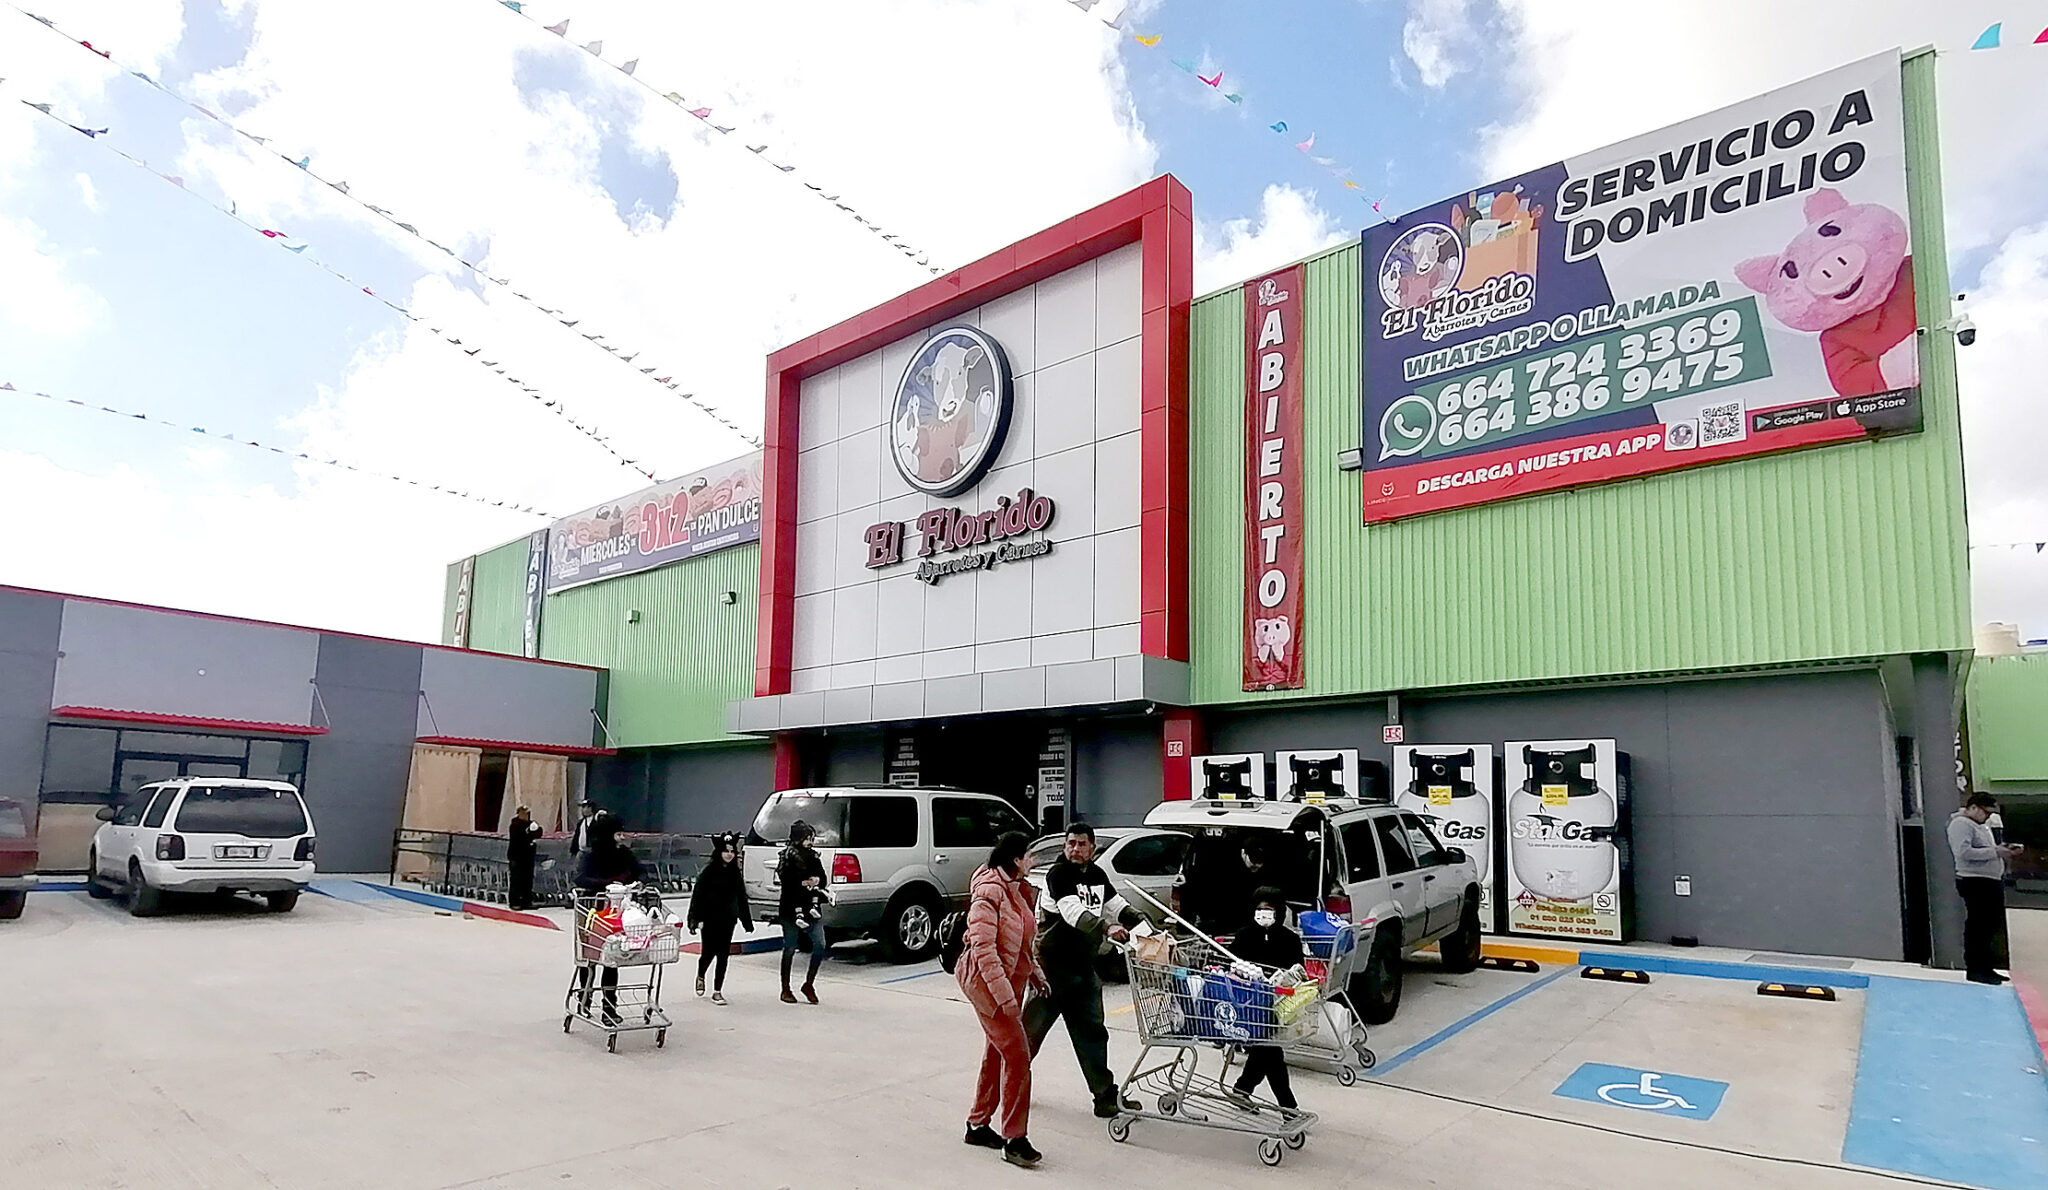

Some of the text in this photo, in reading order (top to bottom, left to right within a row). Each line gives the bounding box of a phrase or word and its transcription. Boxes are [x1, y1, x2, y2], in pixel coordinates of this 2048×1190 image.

[1560, 88, 1874, 216] SERVICIO A
[1570, 141, 1866, 257] DOMICILIO
[1383, 277, 1529, 336] El Florido
[1405, 280, 1721, 378] WHATSAPP O LLAMADA
[1425, 302, 1529, 338] Abarrotes y Carnes
[1437, 308, 1742, 416] 664 724 3369
[1438, 343, 1744, 447] 664 386 9475
[1773, 411, 1805, 427] Google
[1806, 409, 1824, 421] Play
[1855, 403, 1877, 414] App
[1878, 397, 1907, 409] Store
[1257, 308, 1287, 608] ABIERTO
[1416, 433, 1662, 495] DESCARGA NUESTRA APP
[697, 509, 720, 537] PAN
[722, 497, 759, 530] DULCE
[863, 487, 1054, 568] El Florido
[914, 553, 981, 585] Abarrotes
[996, 539, 1052, 562] Carnes
